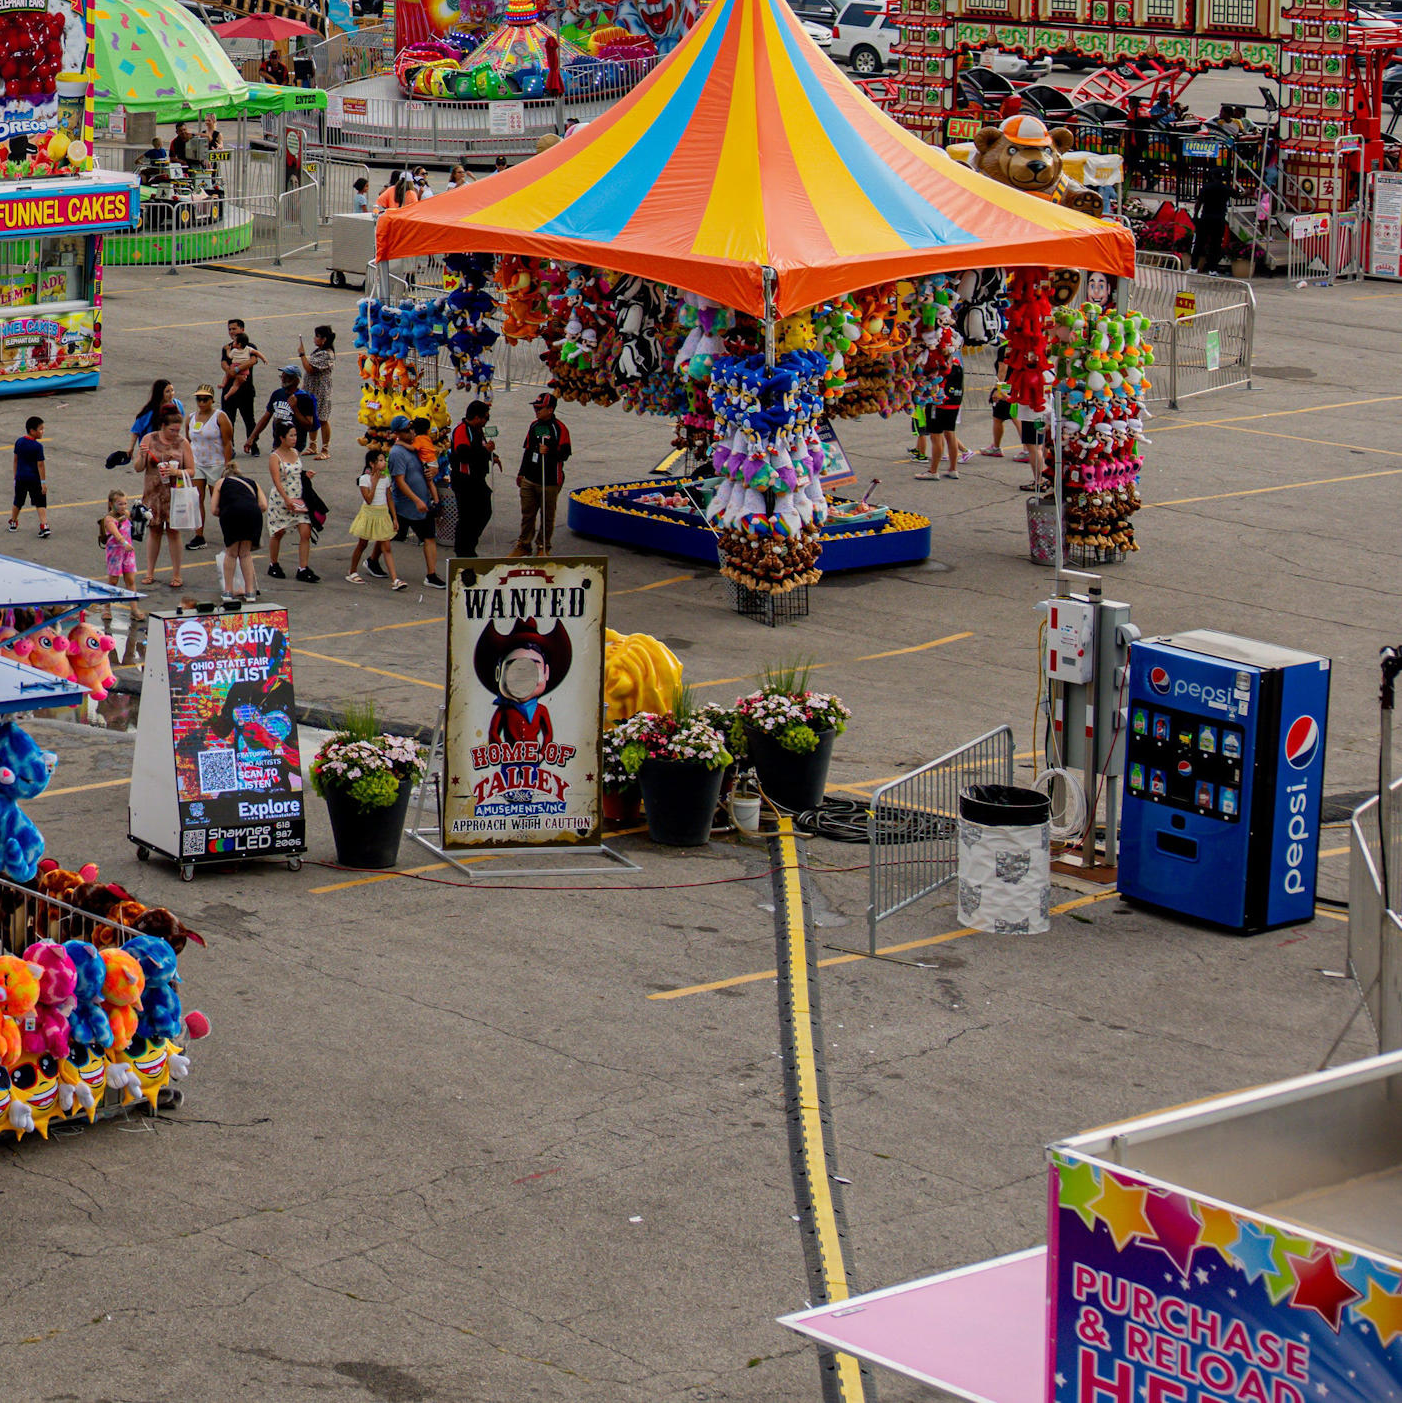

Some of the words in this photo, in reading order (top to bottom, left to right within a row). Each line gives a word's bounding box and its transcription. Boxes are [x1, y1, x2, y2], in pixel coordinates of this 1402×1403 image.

[295, 94, 317, 105] ENTER
[4, 109, 33, 121] Fried
[949, 119, 981, 138] EXIT
[1186, 141, 1216, 151] ENTRANCE
[209, 153, 230, 161] EXIT
[67, 195, 126, 222] CAKES
[26, 319, 59, 336] CAKES
[5, 337, 26, 347] ELEPHANT
[27, 336, 40, 345] EARS
[463, 587, 586, 619] WANTED
[211, 623, 274, 649] Spotify
[191, 660, 215, 671] OHIO
[216, 659, 245, 670] STATE
[246, 657, 269, 669] FAIR
[192, 666, 269, 686] PLAYLIST
[1174, 679, 1232, 705] pepsi
[471, 742, 538, 767] HOME
[545, 742, 577, 764] OF
[255, 759, 281, 767] ARTISTS
[238, 770, 263, 779] SCAN
[265, 768, 277, 777] TO
[239, 780, 271, 789] LISTEN
[474, 766, 571, 806] TALLEY
[238, 799, 300, 819] Explore
[276, 821, 290, 829] 618
[453, 819, 507, 832] APPROACH
[545, 817, 591, 830] CAUTION
[208, 826, 271, 840] Shawnee
[276, 830, 292, 838] 987
[1285, 778, 1307, 895] pepsi
[235, 835, 271, 851] LED
[276, 839, 302, 848] 2006
[1072, 1262, 1310, 1384] PURCHASE
[1076, 1309, 1112, 1353] &
[1126, 1324, 1304, 1403] RELOAD
